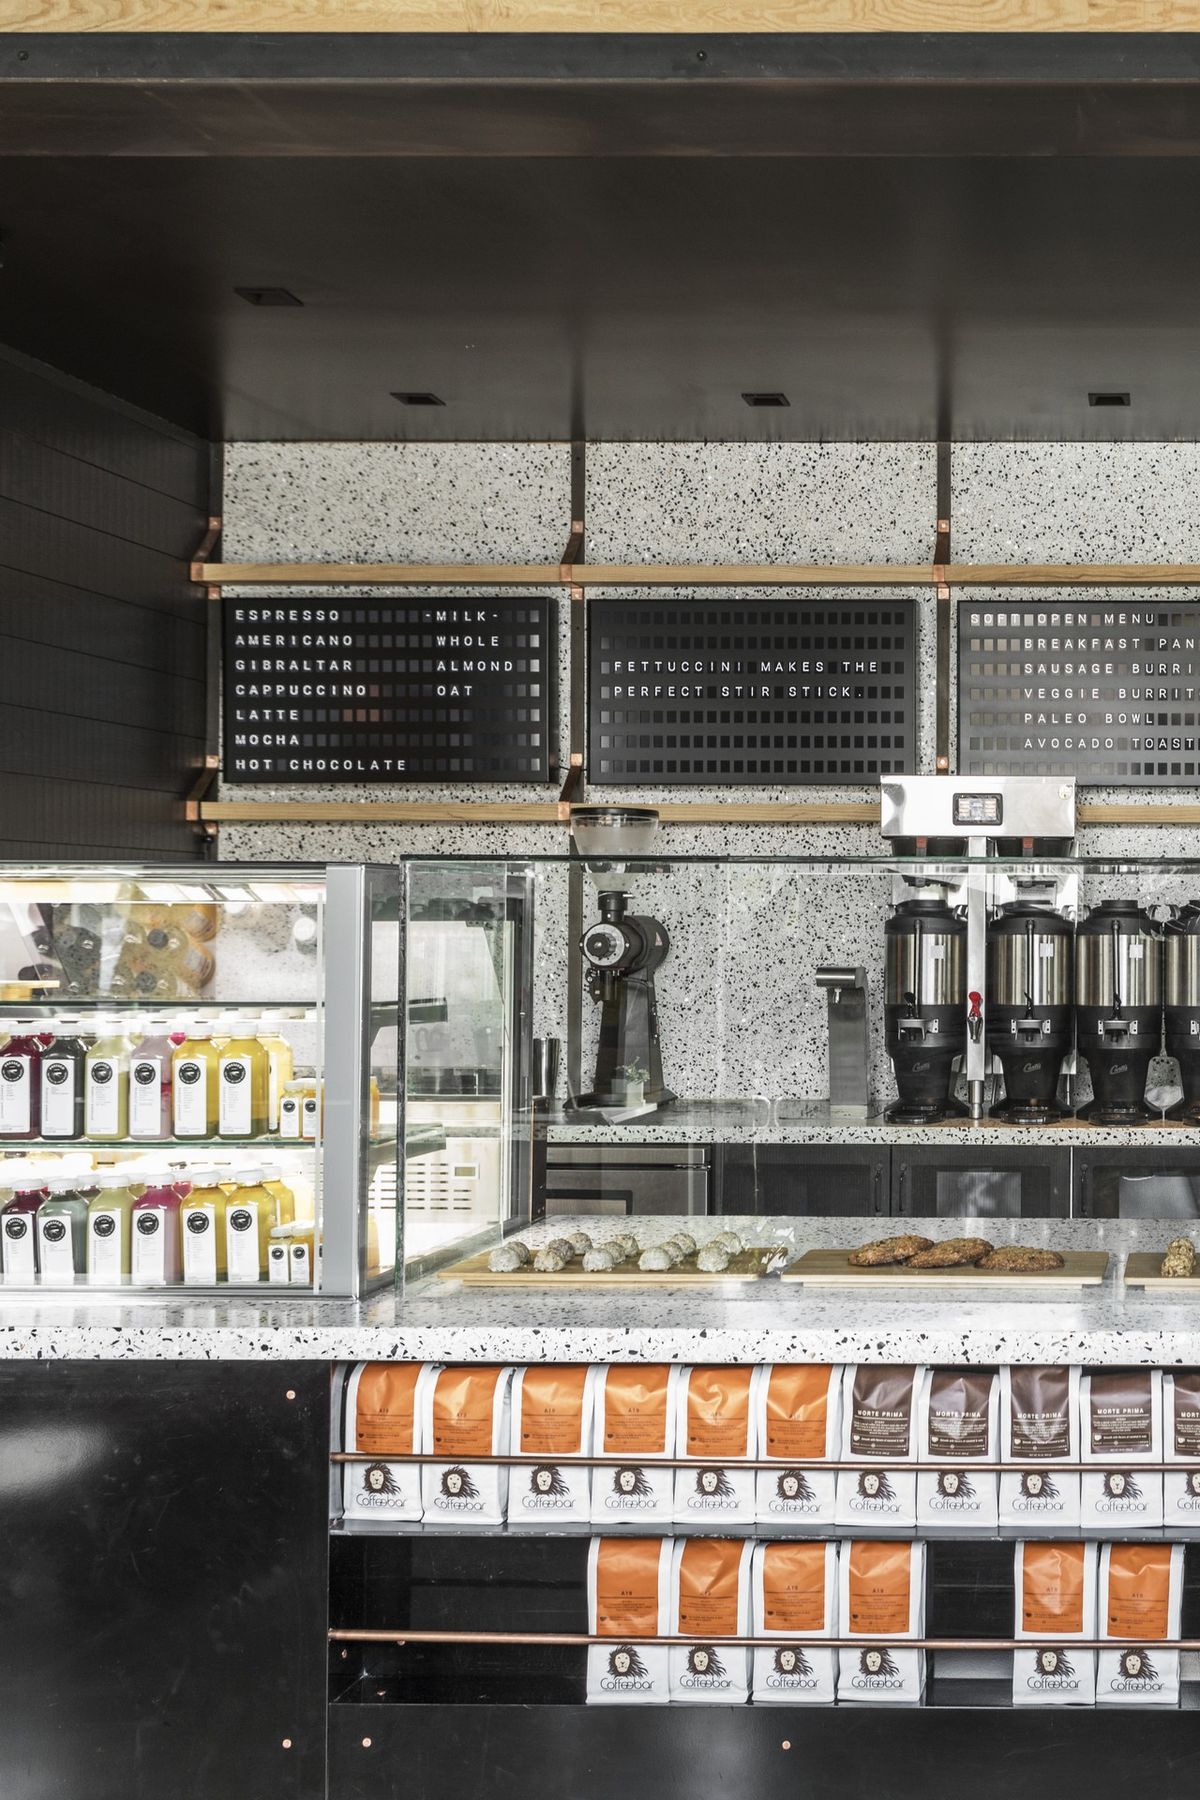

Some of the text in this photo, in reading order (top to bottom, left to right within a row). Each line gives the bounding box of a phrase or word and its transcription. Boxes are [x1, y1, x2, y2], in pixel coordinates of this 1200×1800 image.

[235, 610, 340, 622] ESPRESSO
[970, 613, 1155, 625] SOFT OPEN MENU
[235, 635, 352, 647] AMERICANO
[436, 635, 500, 647] WHOLE
[1024, 638, 1140, 649] BREAKFAST
[235, 660, 353, 671] GIBRALTAR
[436, 660, 513, 672] ALMOND
[614, 661, 877, 673] FETTUCCINI MAKES THE
[1024, 663, 1113, 675] SAUSAGE
[235, 684, 366, 696] CAPPUCCINO
[436, 685, 473, 696] OAT
[614, 686, 863, 697] PERFECT STIR STICK.
[1024, 688, 1100, 699] VEGGIE
[235, 709, 299, 721] LATTE
[1024, 713, 1154, 724] PALEO BOWL
[235, 734, 300, 746] MOCHA
[1024, 737, 1194, 749] AVOCADO TOAST
[235, 759, 406, 771] HOT CHOCOLATE
[356, 1493, 407, 1508] Coffeebar
[433, 1497, 487, 1511] Coffeebar
[521, 1495, 576, 1509] Coffeebar
[604, 1495, 660, 1510] Coffeebar
[687, 1495, 741, 1509] Coffeebar
[768, 1499, 822, 1513] Coffeebar
[848, 1498, 902, 1513] Coffeebar
[928, 1497, 982, 1511] Coffeebar
[1011, 1498, 1066, 1511] Coffeebar
[1095, 1499, 1149, 1513] Coffeebar
[600, 1677, 654, 1691] Coffeebar
[679, 1674, 732, 1689] Coffeebar
[766, 1675, 820, 1689] Coffeebar
[851, 1675, 905, 1689] Coffeebar
[1026, 1676, 1082, 1689] Coffeebar
[1110, 1678, 1165, 1692] Coffeebar
